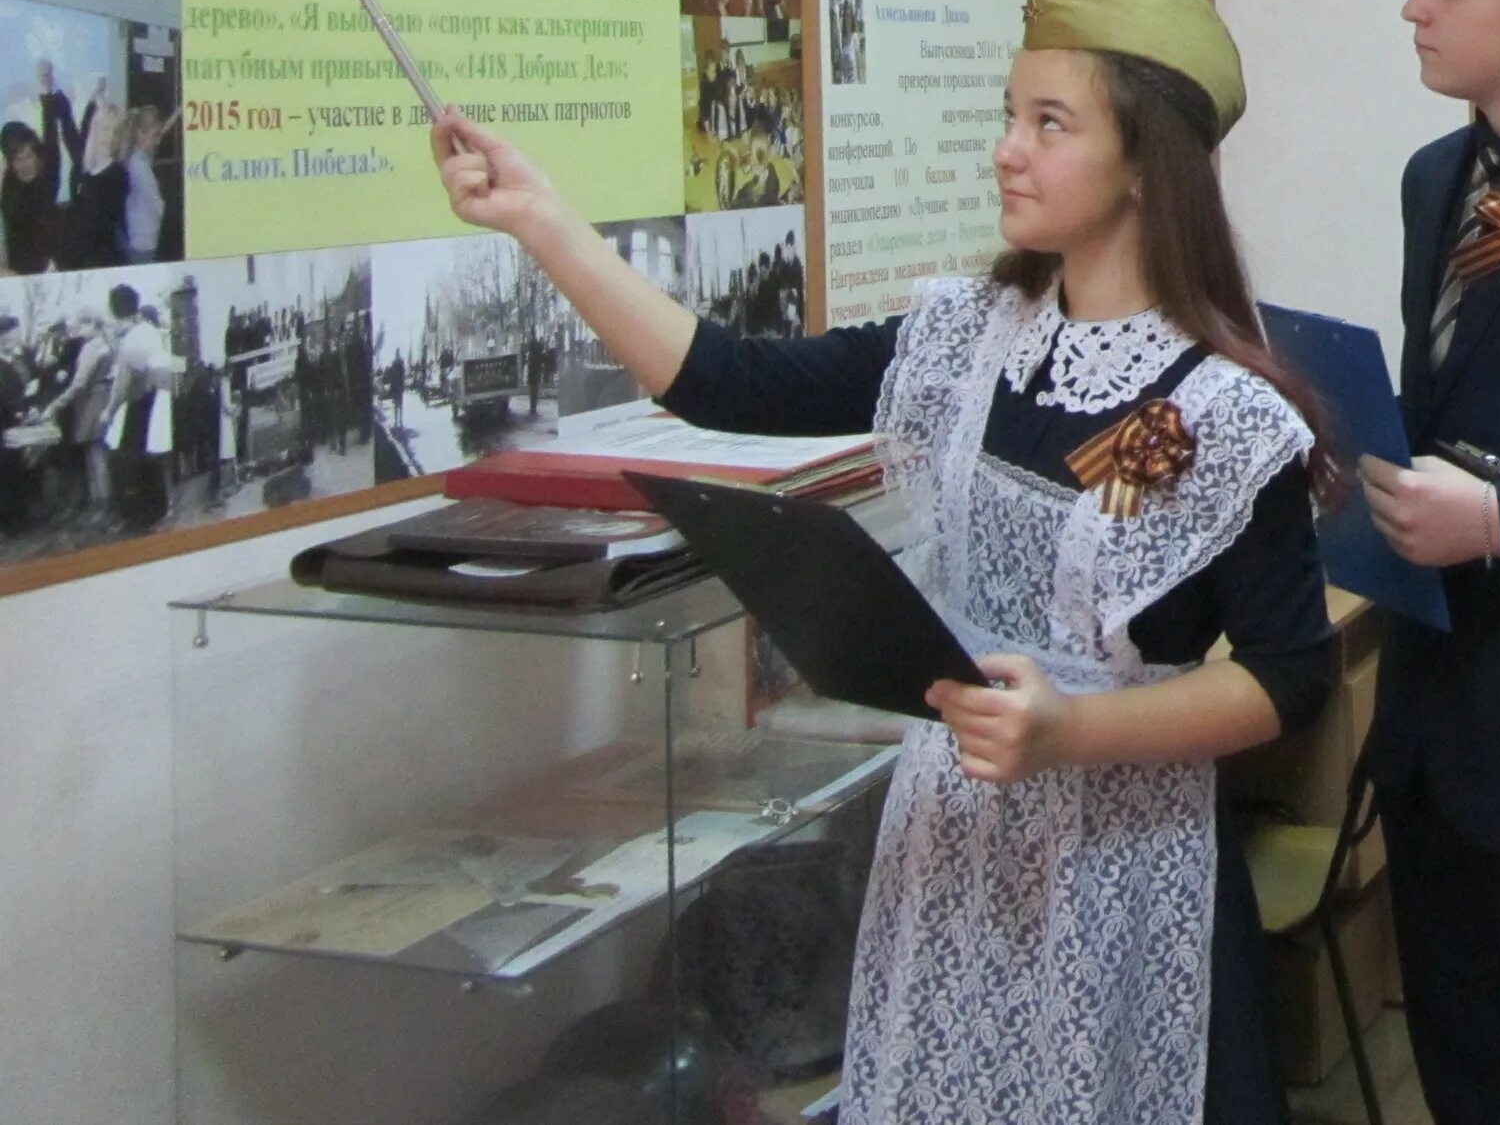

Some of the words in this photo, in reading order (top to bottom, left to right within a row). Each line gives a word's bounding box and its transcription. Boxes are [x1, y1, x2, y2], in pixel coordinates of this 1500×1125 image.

[186, 100, 240, 131] 2015
[247, 106, 282, 130] год
[308, 103, 385, 136] участие
[392, 107, 402, 126] в
[501, 101, 549, 123] юных
[555, 100, 632, 126] патриотов
[187, 151, 286, 183] «Салют,
